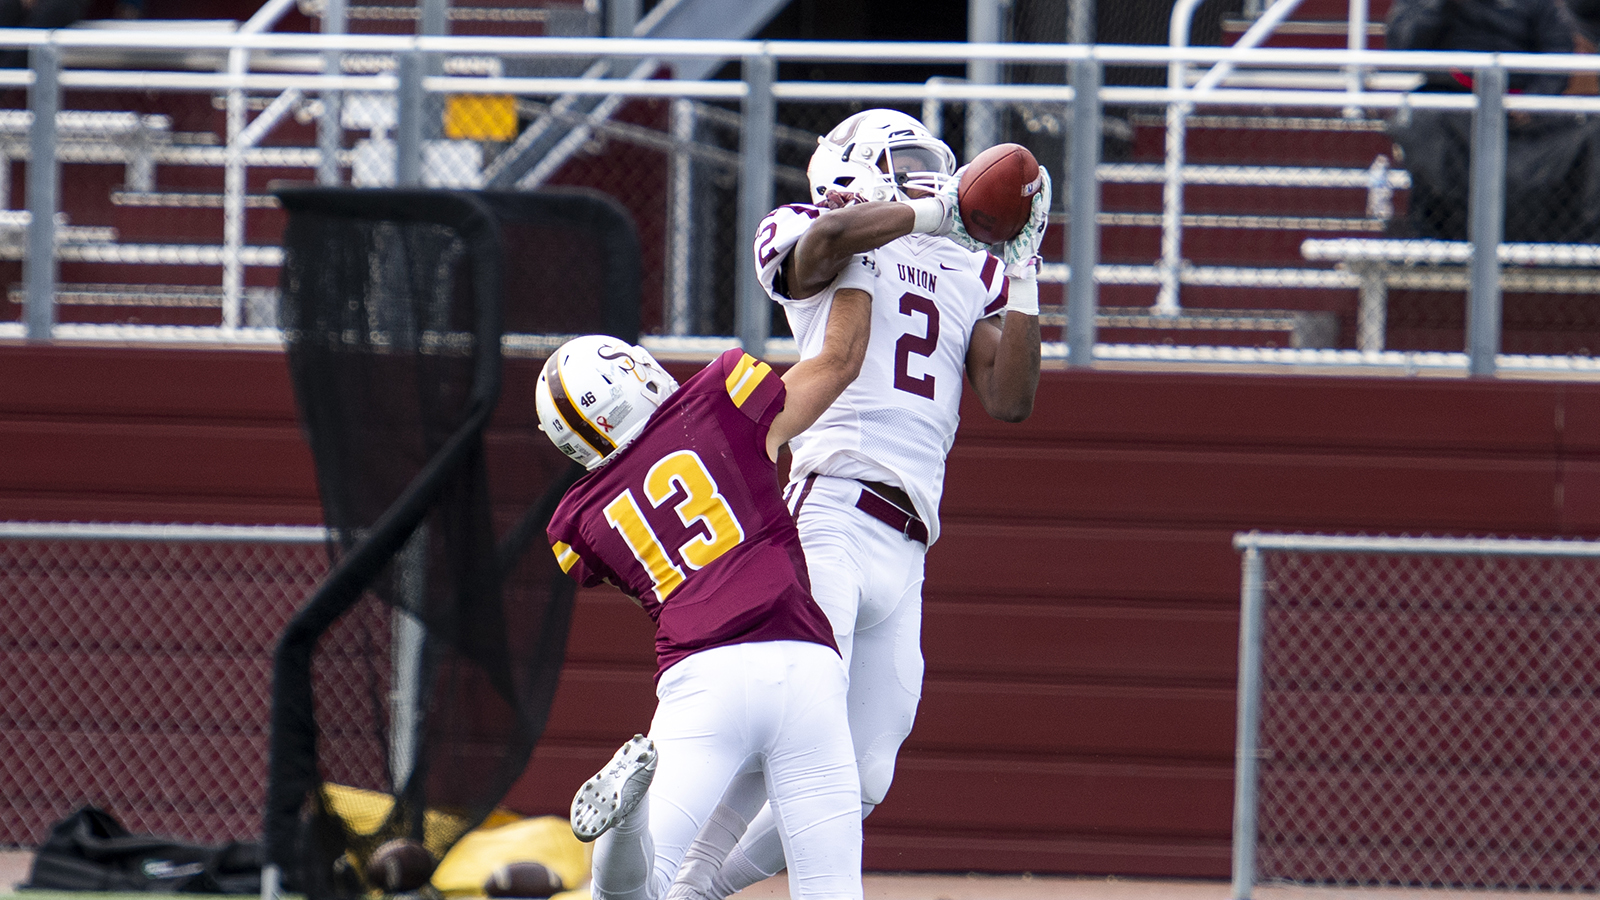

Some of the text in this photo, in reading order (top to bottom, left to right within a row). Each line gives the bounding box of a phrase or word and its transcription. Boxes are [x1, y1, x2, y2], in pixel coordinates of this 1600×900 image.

[758, 221, 780, 269] 2
[897, 263, 937, 293] UNION
[893, 291, 940, 401] 2
[580, 391, 597, 408] 46
[602, 449, 745, 604] 13
